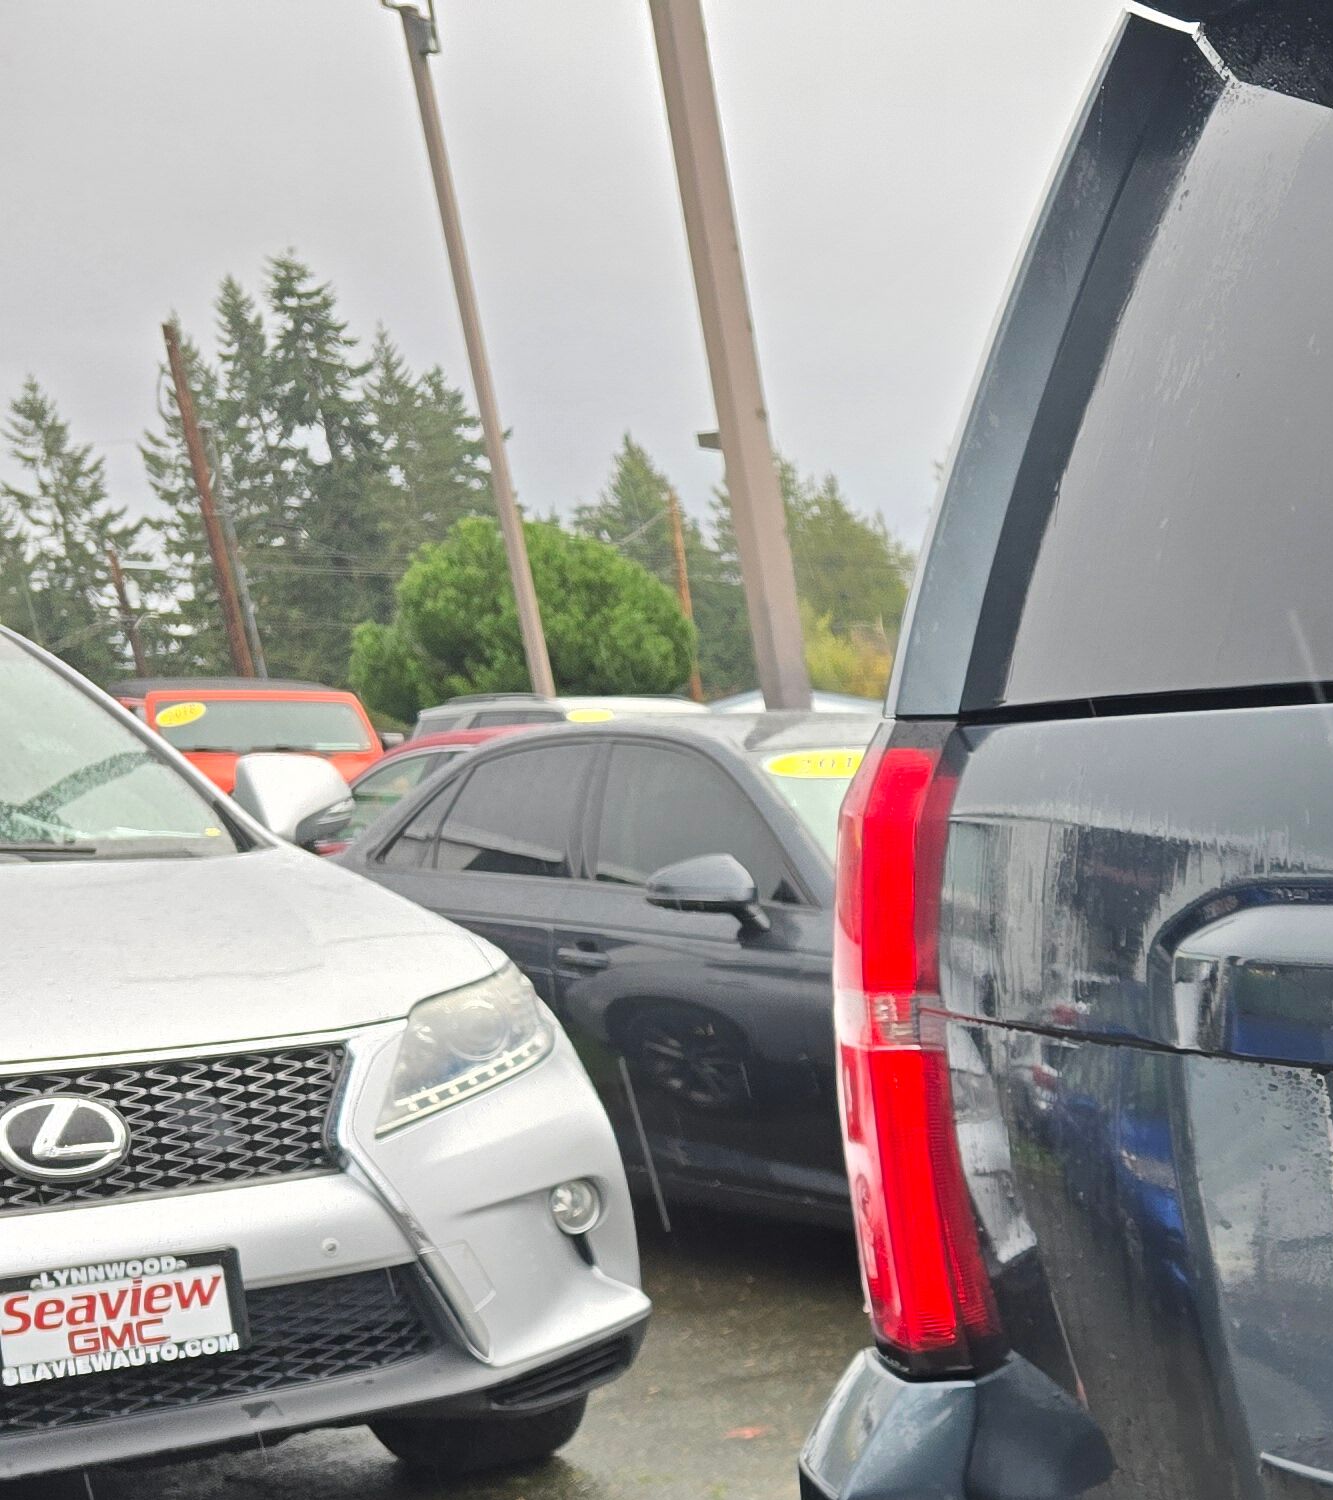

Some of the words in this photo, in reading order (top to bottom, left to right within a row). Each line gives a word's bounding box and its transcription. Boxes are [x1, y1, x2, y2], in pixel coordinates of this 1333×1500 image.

[40, 1255, 177, 1289] LYNNWOOD
[1, 1275, 222, 1336] Seaview
[1, 1333, 240, 1387] SEAVIEWAUTO.COM
[67, 1318, 171, 1357] GMC
